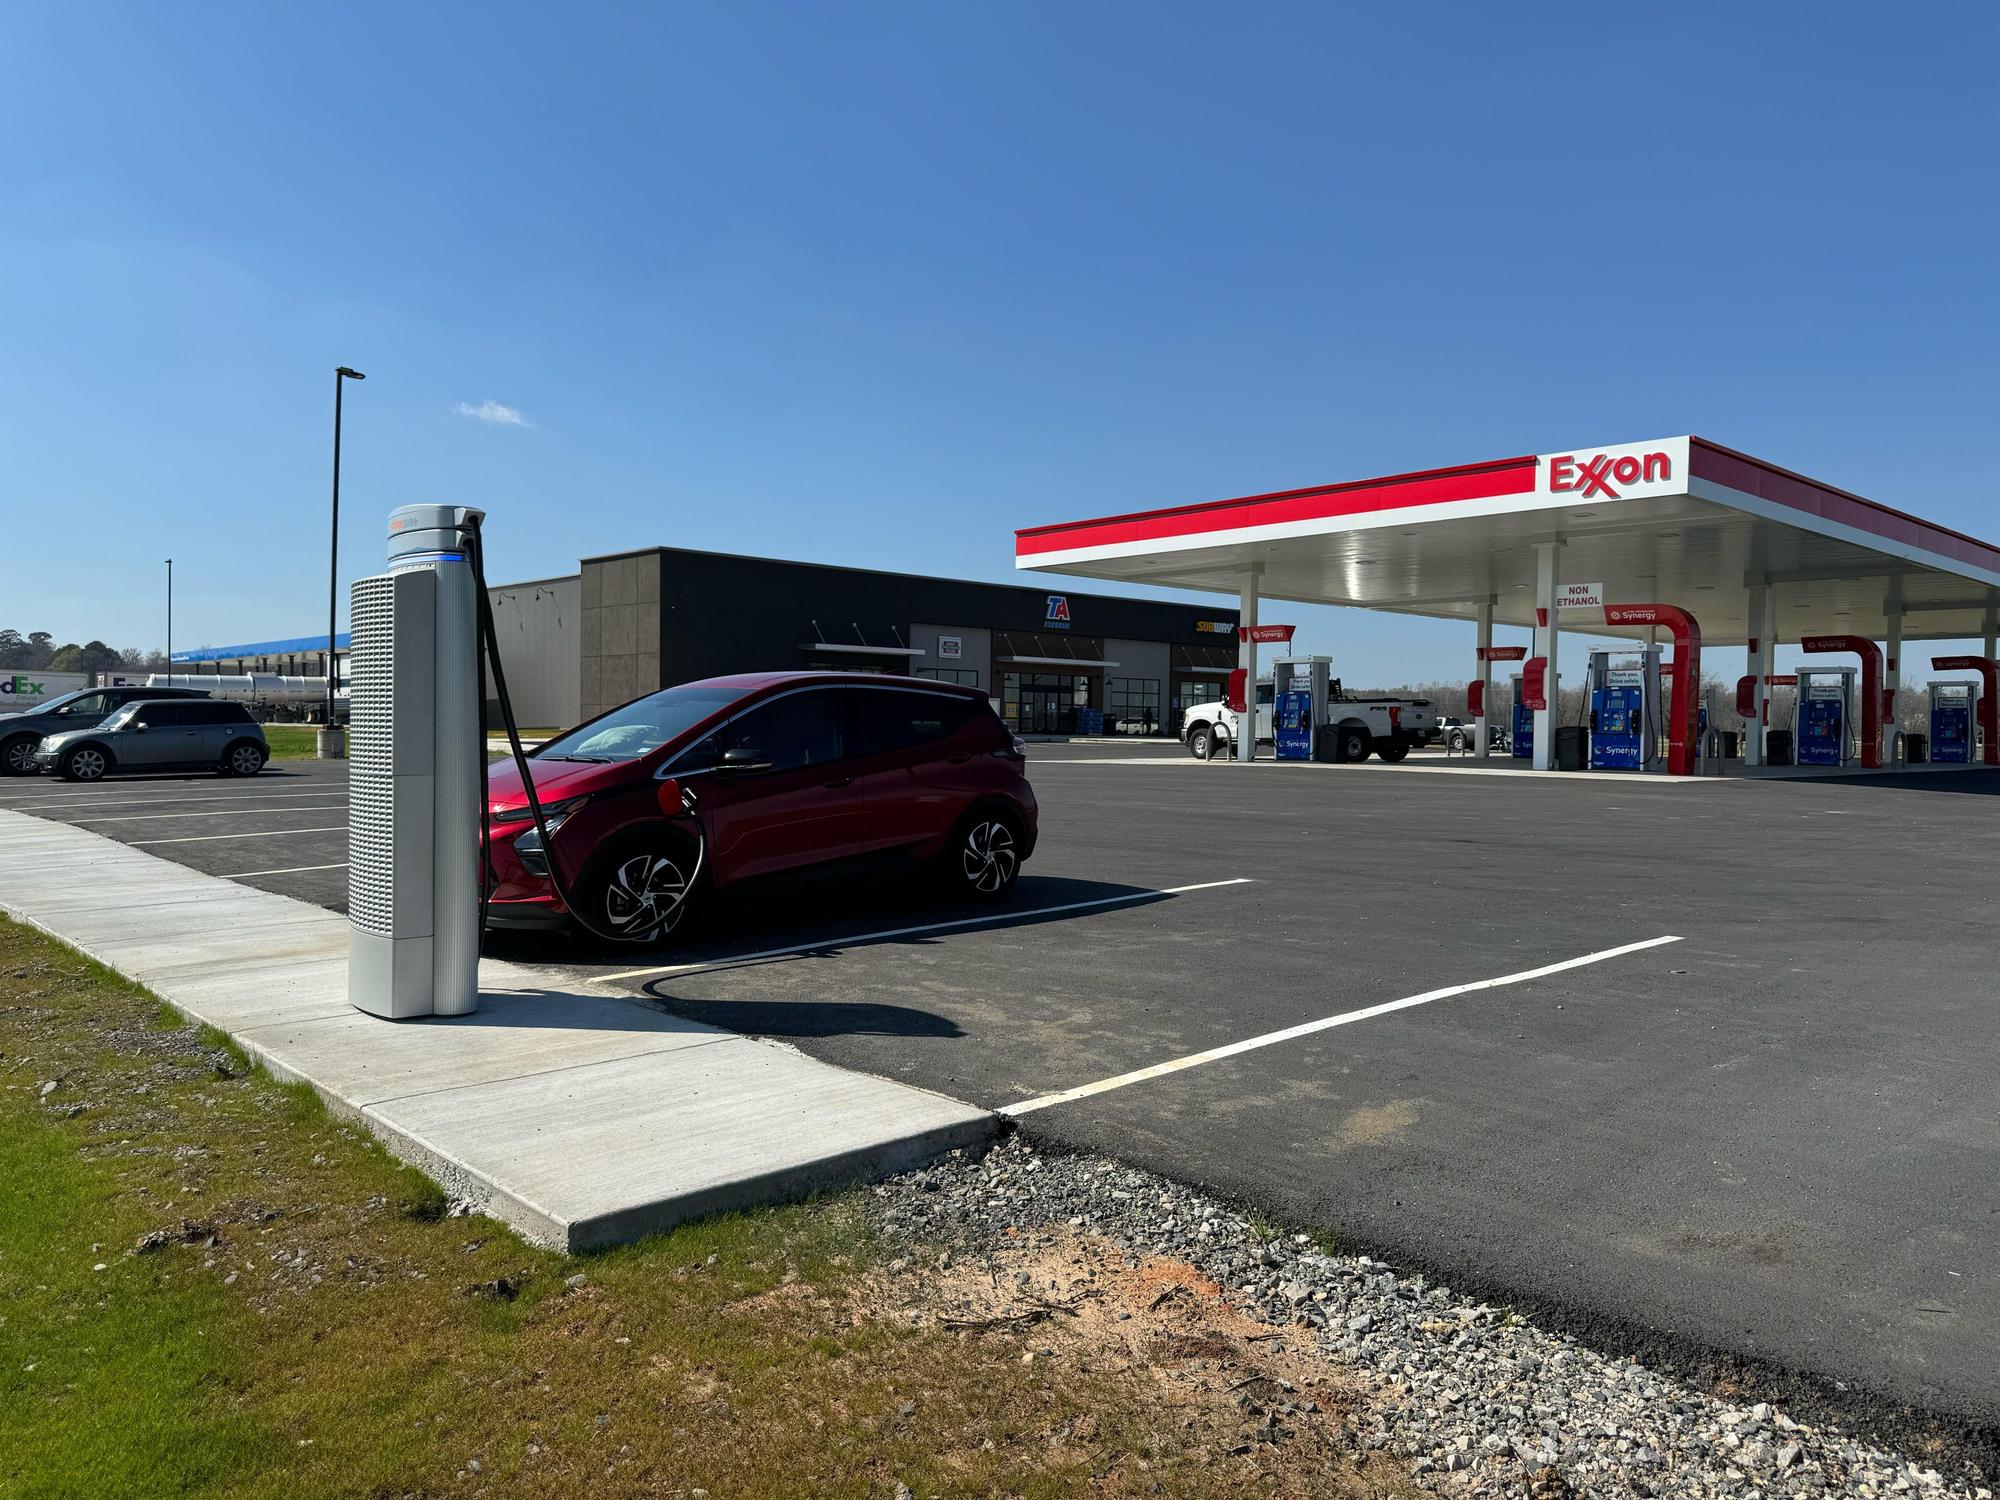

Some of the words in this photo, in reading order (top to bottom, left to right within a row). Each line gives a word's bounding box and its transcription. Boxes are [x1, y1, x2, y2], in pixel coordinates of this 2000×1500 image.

[1550, 452, 1670, 498] Exxon
[1568, 586, 1589, 595] NON
[1556, 597, 1600, 606] ETHANOL
[1046, 596, 1070, 620] TA
[1622, 611, 1656, 620] Synergy
[1196, 621, 1234, 634] SUBWAY
[1261, 631, 1284, 639] Synergy
[1818, 641, 1846, 649] Synergy
[0, 676, 45, 694] dEx
[1286, 740, 1309, 748] Synergy
[1606, 746, 1638, 756] Synergy
